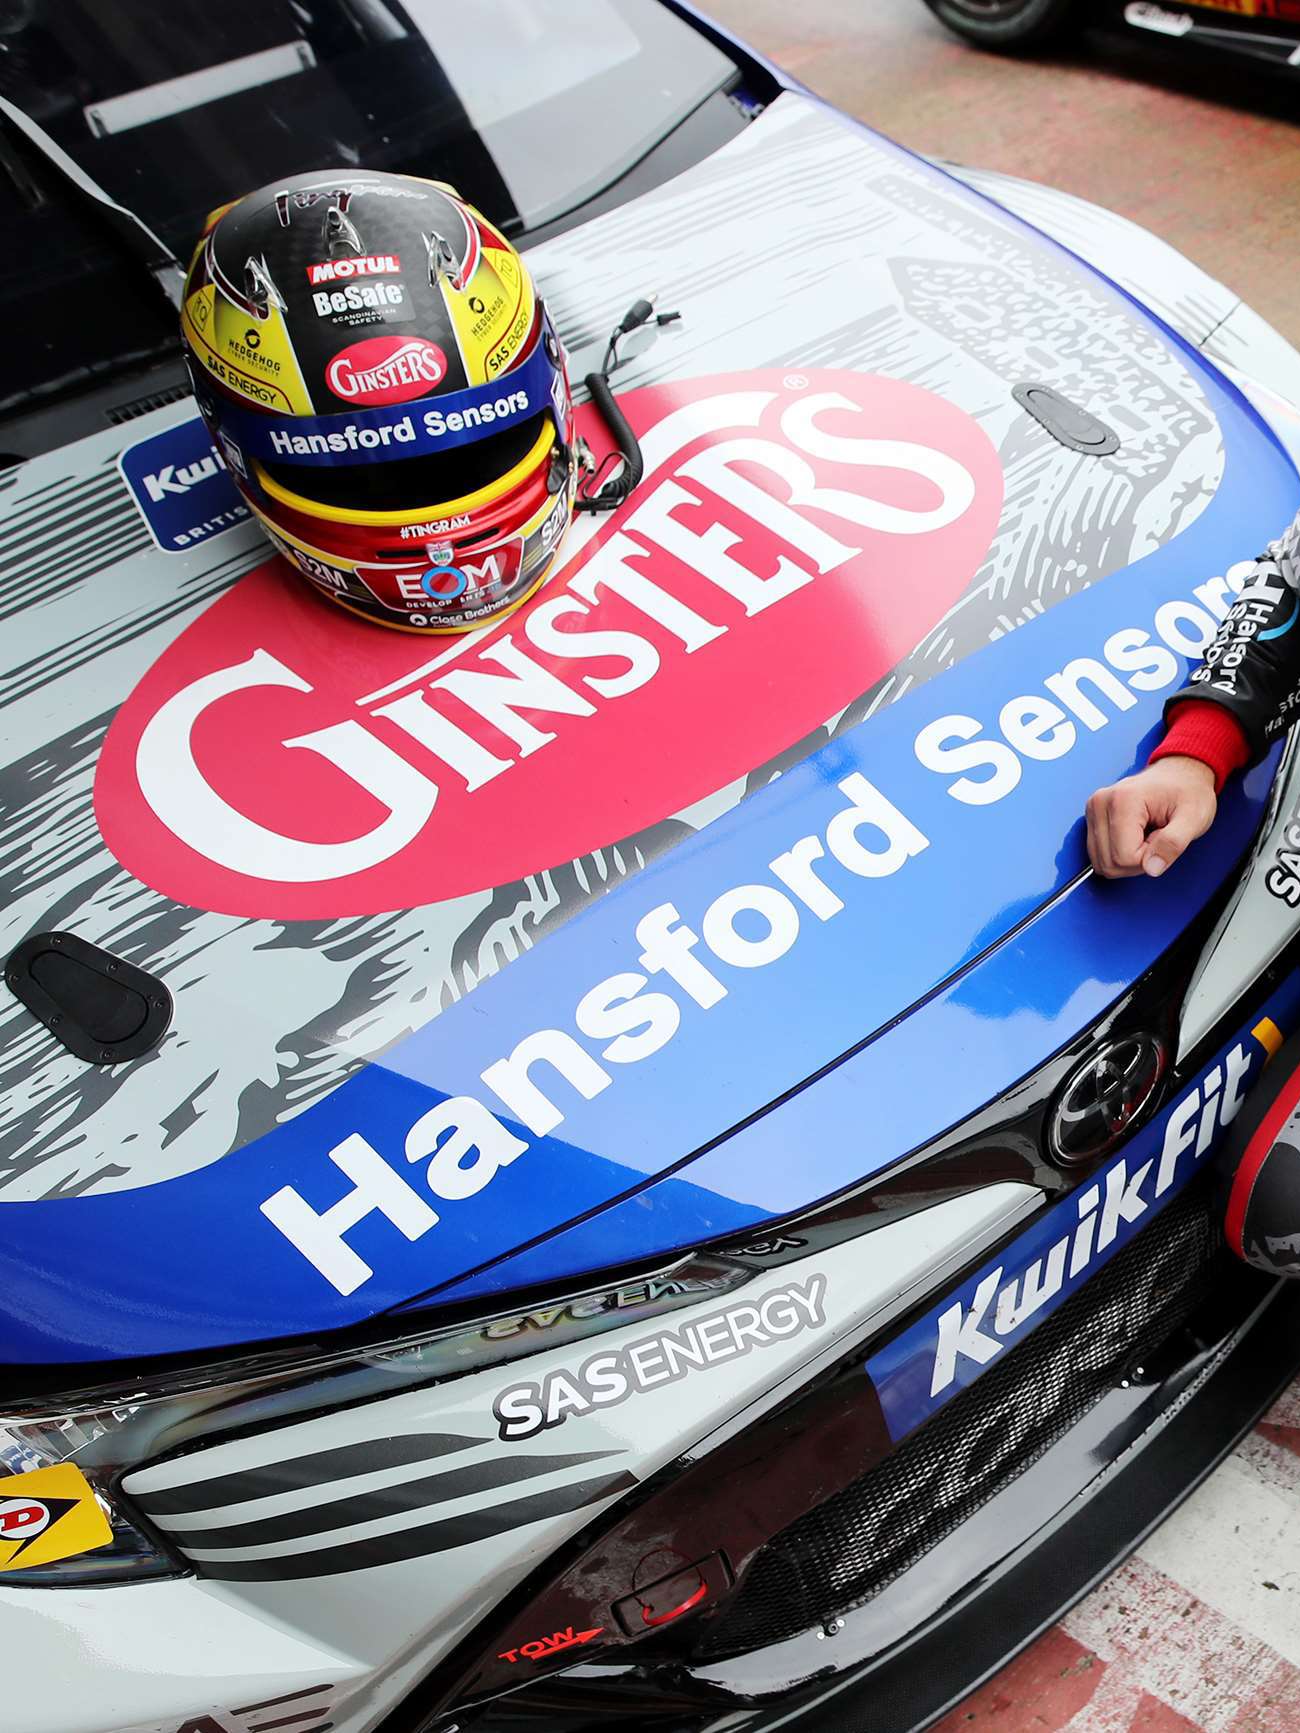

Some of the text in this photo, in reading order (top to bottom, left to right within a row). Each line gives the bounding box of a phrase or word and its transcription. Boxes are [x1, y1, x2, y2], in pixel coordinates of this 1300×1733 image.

[313, 256, 400, 283] MOTUL
[312, 283, 403, 317] BeSafe
[349, 315, 384, 326] SAFETY
[229, 339, 281, 372] HEDGEHOG
[330, 342, 442, 397] GINSTERS
[489, 346, 510, 372] SAS
[207, 355, 277, 405] SAS ENERGY
[269, 388, 530, 456] Hansford Sensors
[142, 446, 227, 502] Kwi
[173, 506, 249, 545] BRITIS
[400, 514, 472, 540] #TINGRAM
[396, 554, 501, 600] EOM
[429, 614, 463, 625] Close
[464, 597, 511, 620] Brothers
[136, 391, 977, 883] GINSTERS
[259, 769, 930, 1297] Hansford
[497, 1625, 579, 1664] TOW
